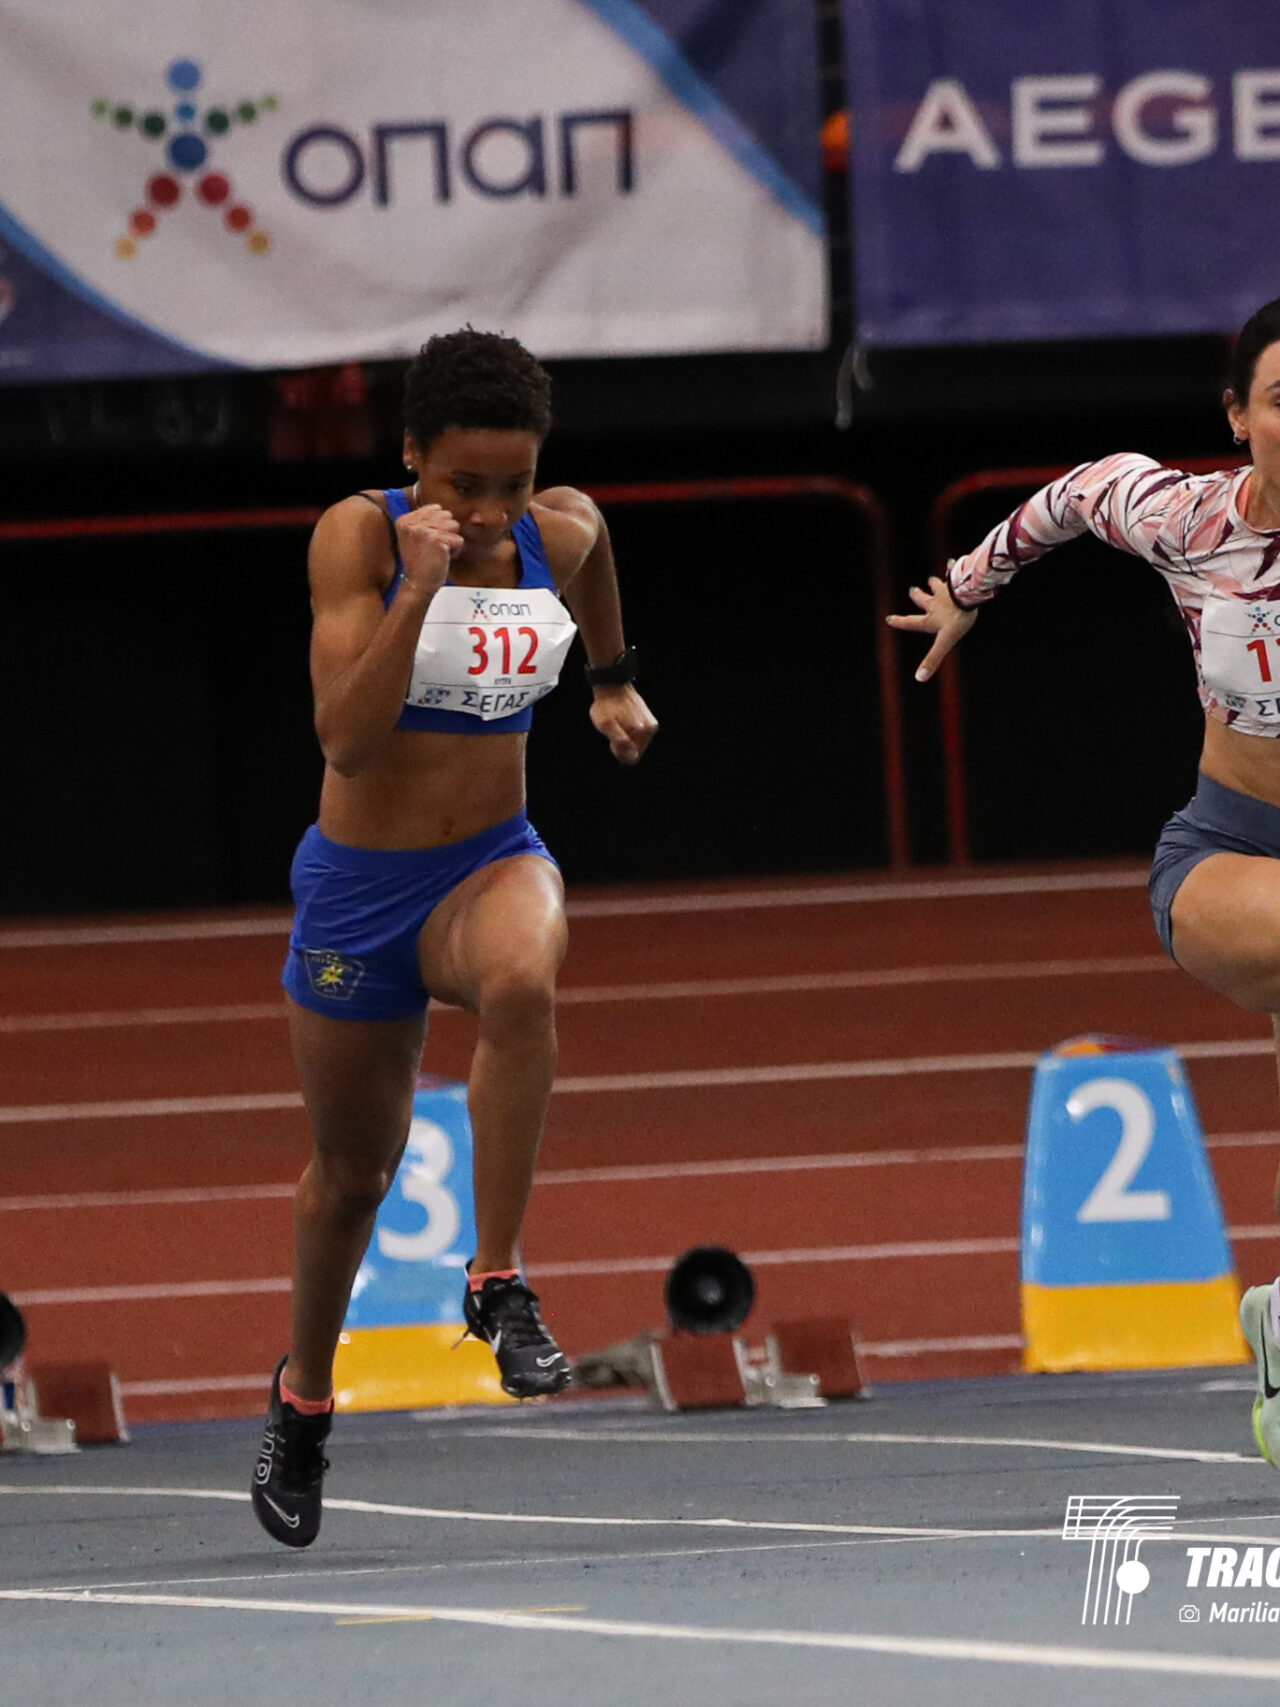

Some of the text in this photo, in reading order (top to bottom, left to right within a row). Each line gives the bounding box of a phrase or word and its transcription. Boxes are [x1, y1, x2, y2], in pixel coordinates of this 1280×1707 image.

[467, 626, 539, 676] 312
[461, 690, 531, 713] ΣΕΓΑΣ
[377, 1116, 460, 1262] 3
[1065, 1077, 1172, 1224] 2
